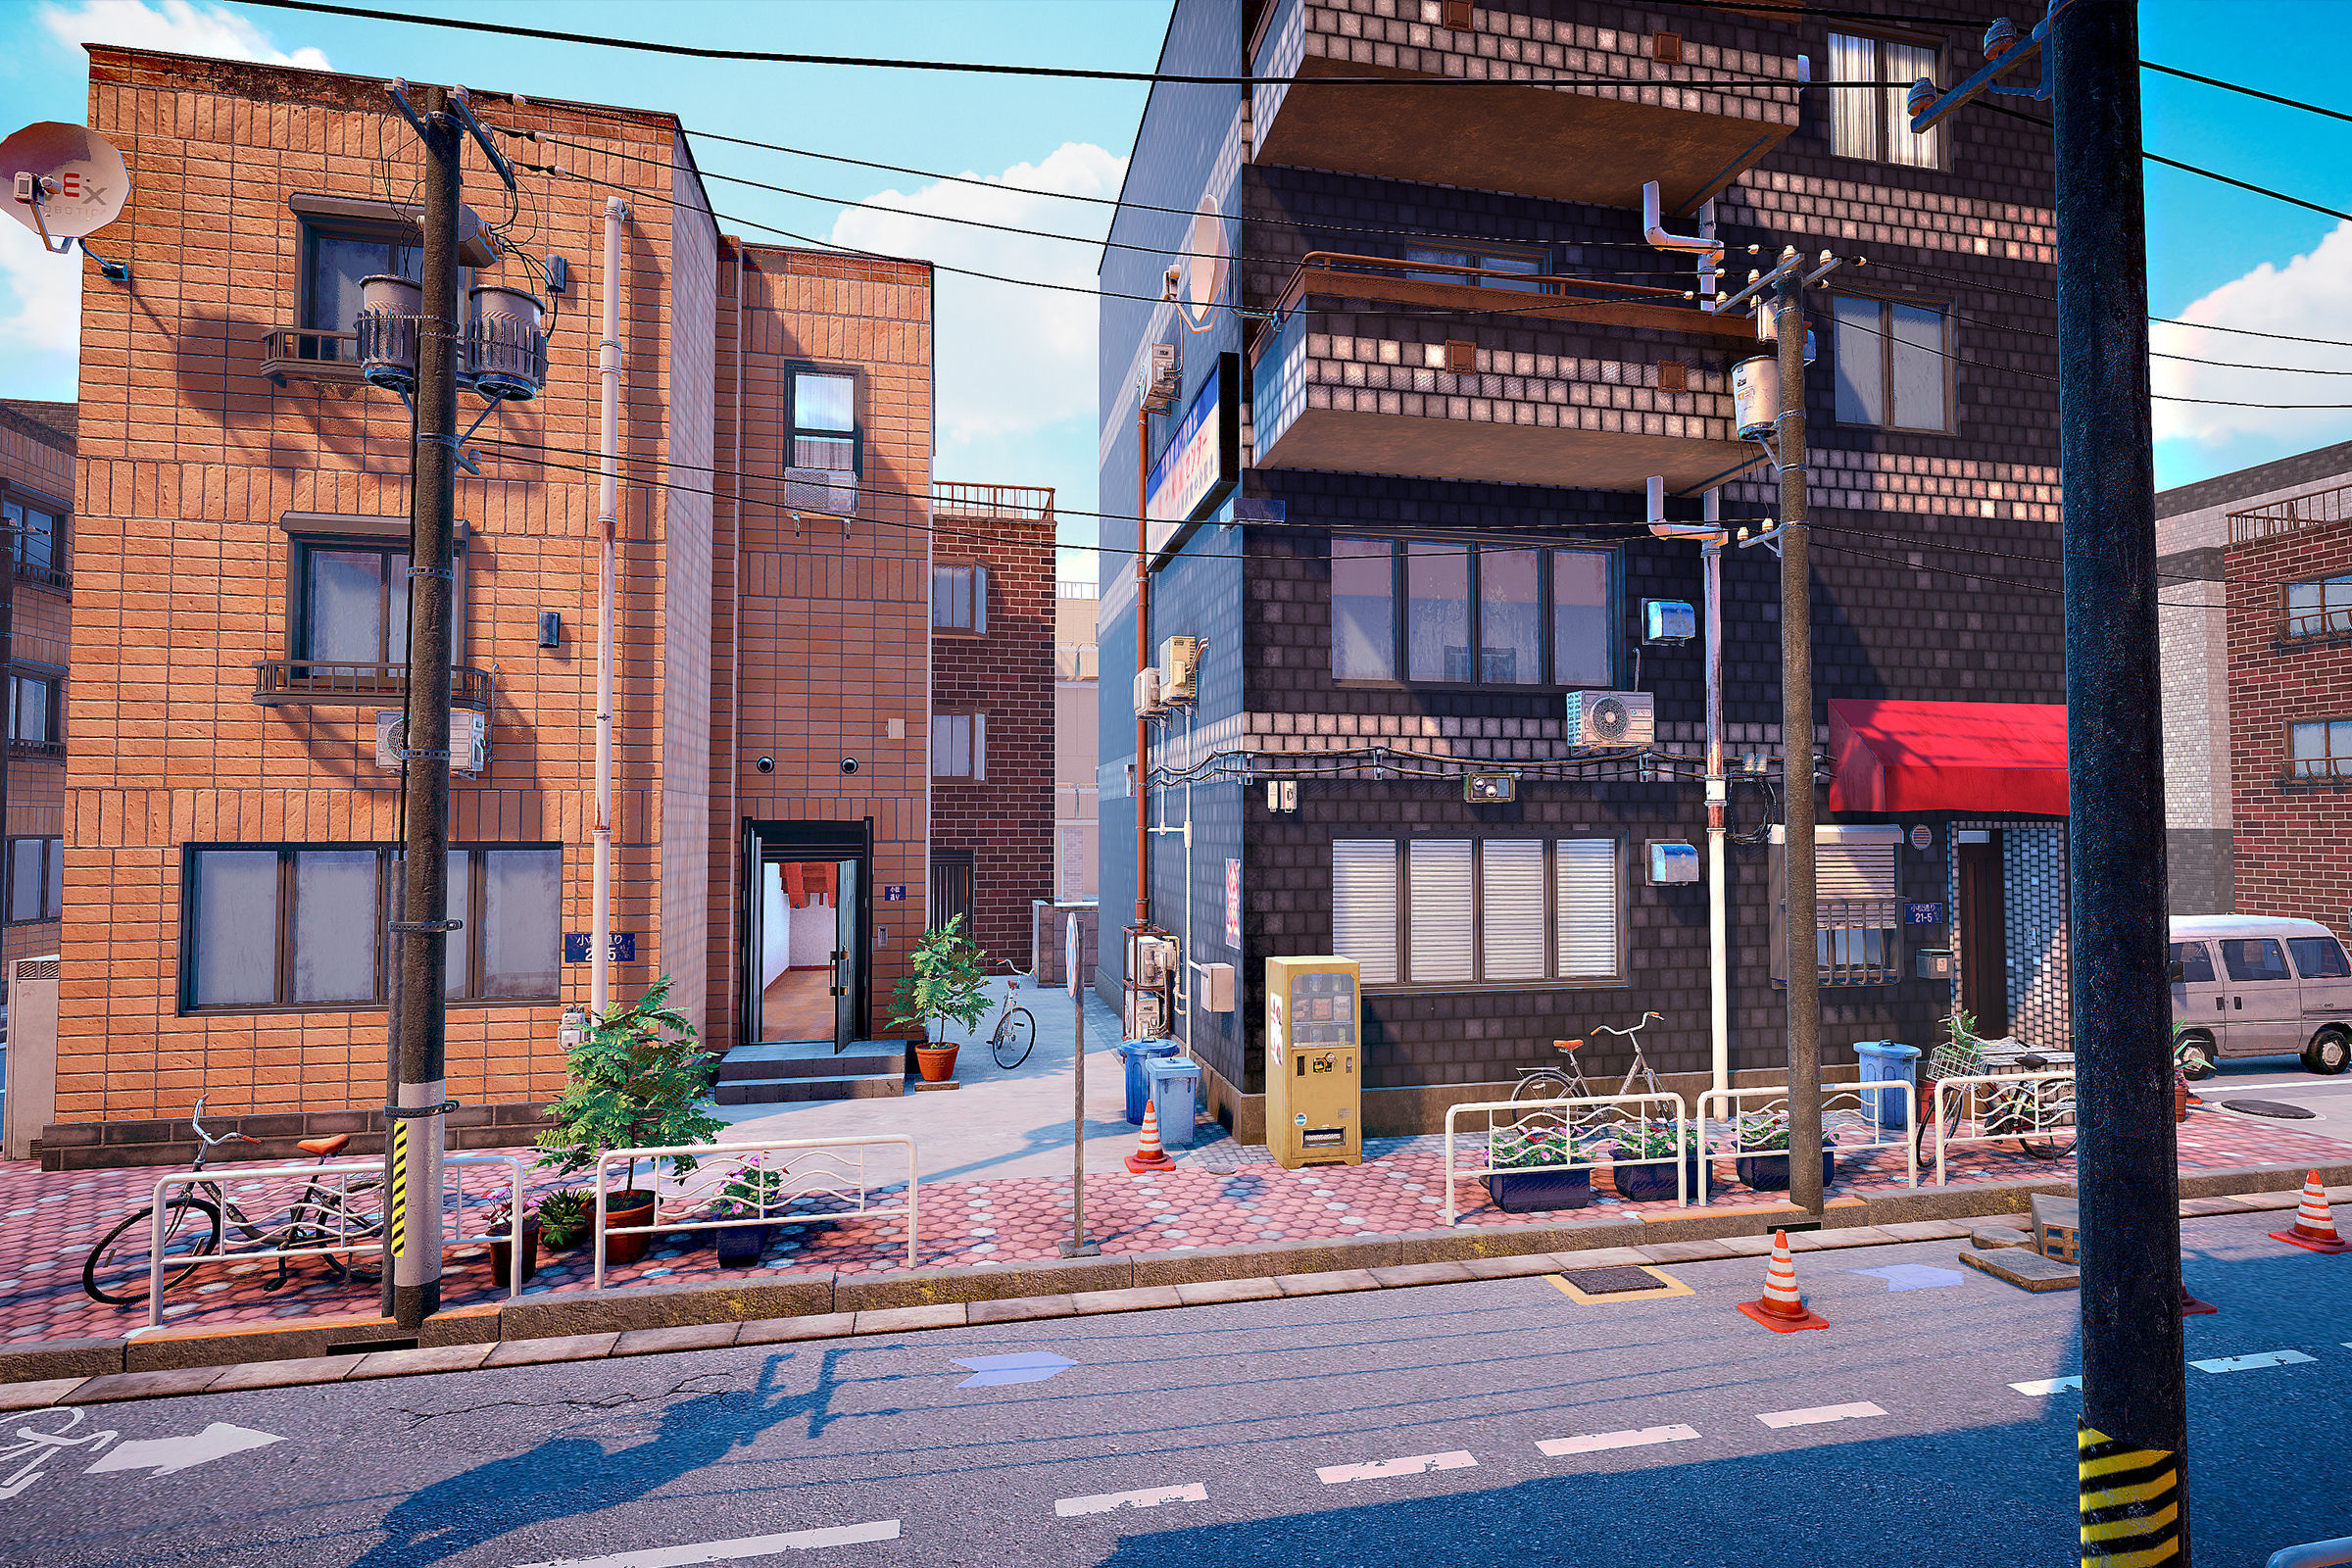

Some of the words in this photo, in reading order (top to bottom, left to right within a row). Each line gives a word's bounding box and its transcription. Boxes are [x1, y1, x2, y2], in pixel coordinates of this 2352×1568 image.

[1915, 912, 1933, 923] 21-5
[576, 934, 622, 946] 小り
[585, 947, 616, 961] 25
